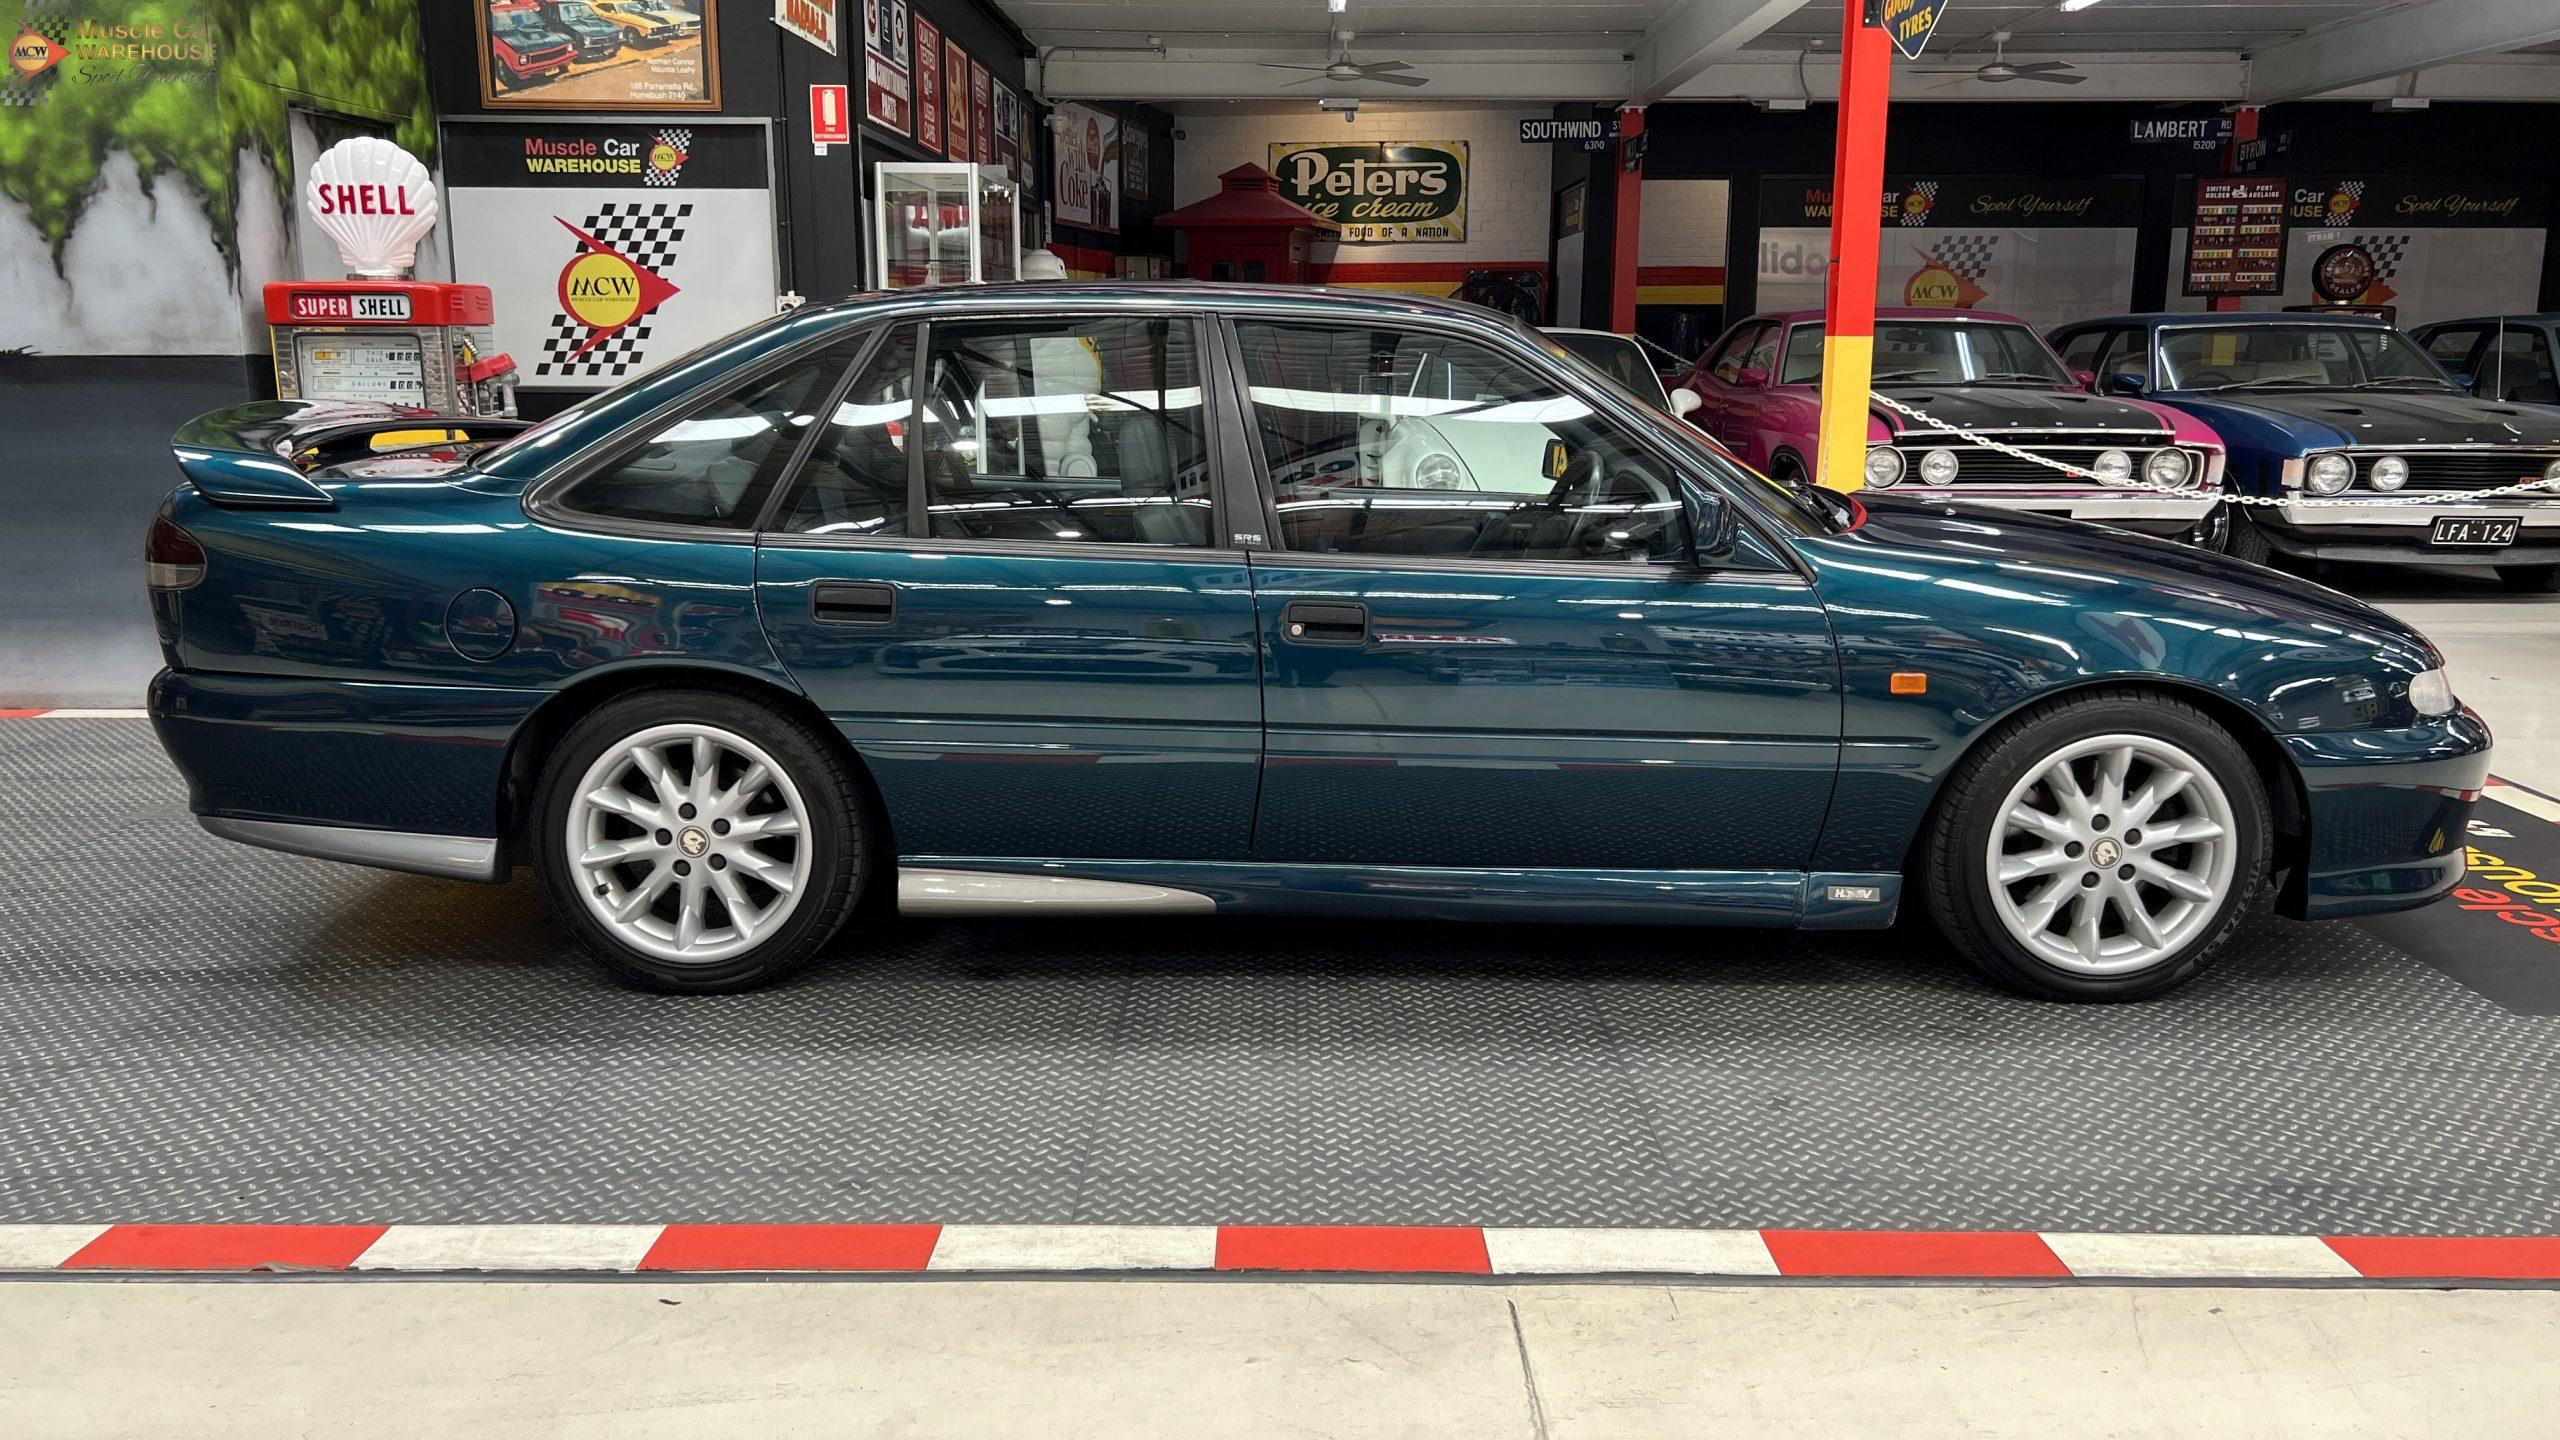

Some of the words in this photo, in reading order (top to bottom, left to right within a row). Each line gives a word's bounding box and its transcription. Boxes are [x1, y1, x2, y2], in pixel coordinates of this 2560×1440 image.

[1899, 6, 1932, 42] TYRES
[1521, 120, 1601, 140] SOUTHWIND
[2133, 120, 2208, 139] LAMBERT
[2220, 120, 2232, 130] RD
[525, 138, 597, 156] Muscle
[603, 138, 640, 157] Car
[1584, 140, 1605, 151] 6300
[2239, 138, 2267, 162] BYRON
[526, 158, 641, 174] WAREHOUSE
[1289, 151, 1448, 197] Peters
[1060, 160, 1089, 210] Coke
[319, 183, 415, 215] SHELL
[2248, 191, 2280, 199] ADELAIDE
[2294, 188, 2325, 204] Car
[1351, 196, 1439, 218] cream
[1970, 195, 2016, 218] Spoil
[2018, 193, 2094, 219] Yourself
[2290, 205, 2324, 218] USE
[2394, 193, 2442, 216] Spoil
[2443, 193, 2521, 218] Yourself
[1349, 226, 1373, 238] FOOD
[1382, 226, 1393, 238] OF
[1401, 226, 1408, 238] A
[1415, 226, 1449, 238] NATION
[571, 276, 636, 296] MCW
[1911, 285, 1958, 299] MCW
[2330, 283, 2362, 295] DEALER
[299, 298, 348, 316] SUPER
[359, 298, 405, 316] SHELL
[1234, 533, 1262, 541] SRS
